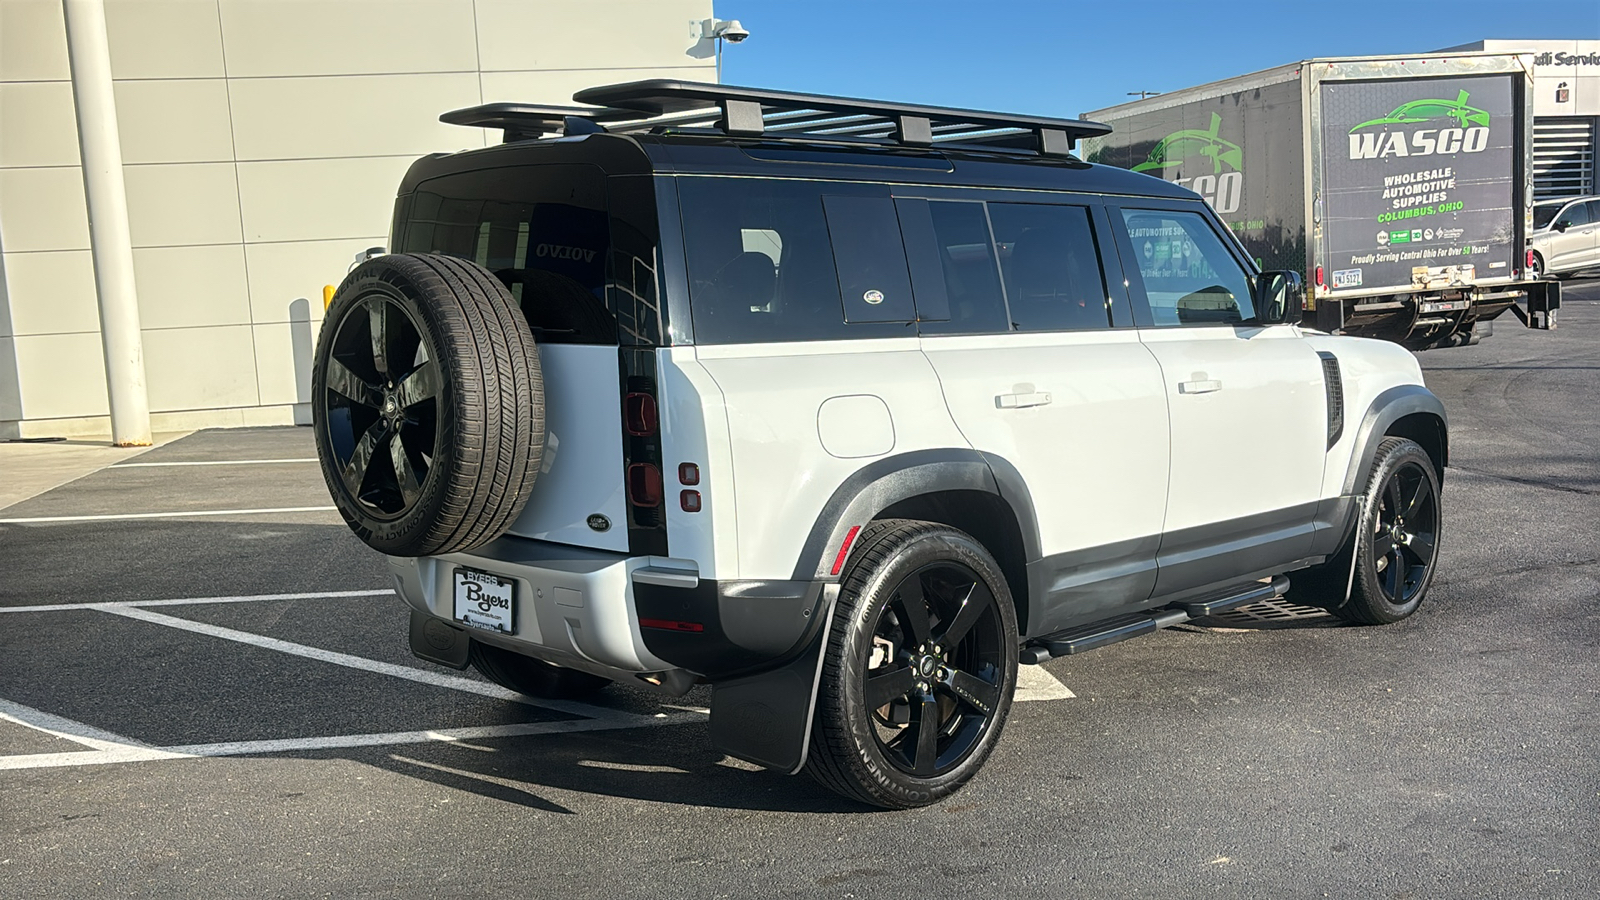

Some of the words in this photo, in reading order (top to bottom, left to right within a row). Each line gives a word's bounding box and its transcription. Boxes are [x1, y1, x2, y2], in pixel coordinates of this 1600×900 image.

[1348, 127, 1490, 160] WASCO
[1384, 167, 1452, 187] WHOLESALE
[1382, 179, 1455, 199] AUTOMOTIVE
[1392, 191, 1447, 209] SUPPLIES
[1377, 206, 1437, 223] COLUMBUS,
[1438, 200, 1464, 213] OHIO
[1247, 219, 1264, 231] OHIO
[1350, 253, 1376, 265] Proudly
[1375, 252, 1400, 263] Serving
[1400, 249, 1423, 261] Central
[1422, 248, 1437, 259] Ohio
[1437, 247, 1448, 258] For
[1447, 247, 1462, 256] Over
[1462, 246, 1471, 255] 50
[1471, 243, 1490, 254] Years!
[467, 571, 498, 586] BYERS
[460, 580, 509, 612] Byers
